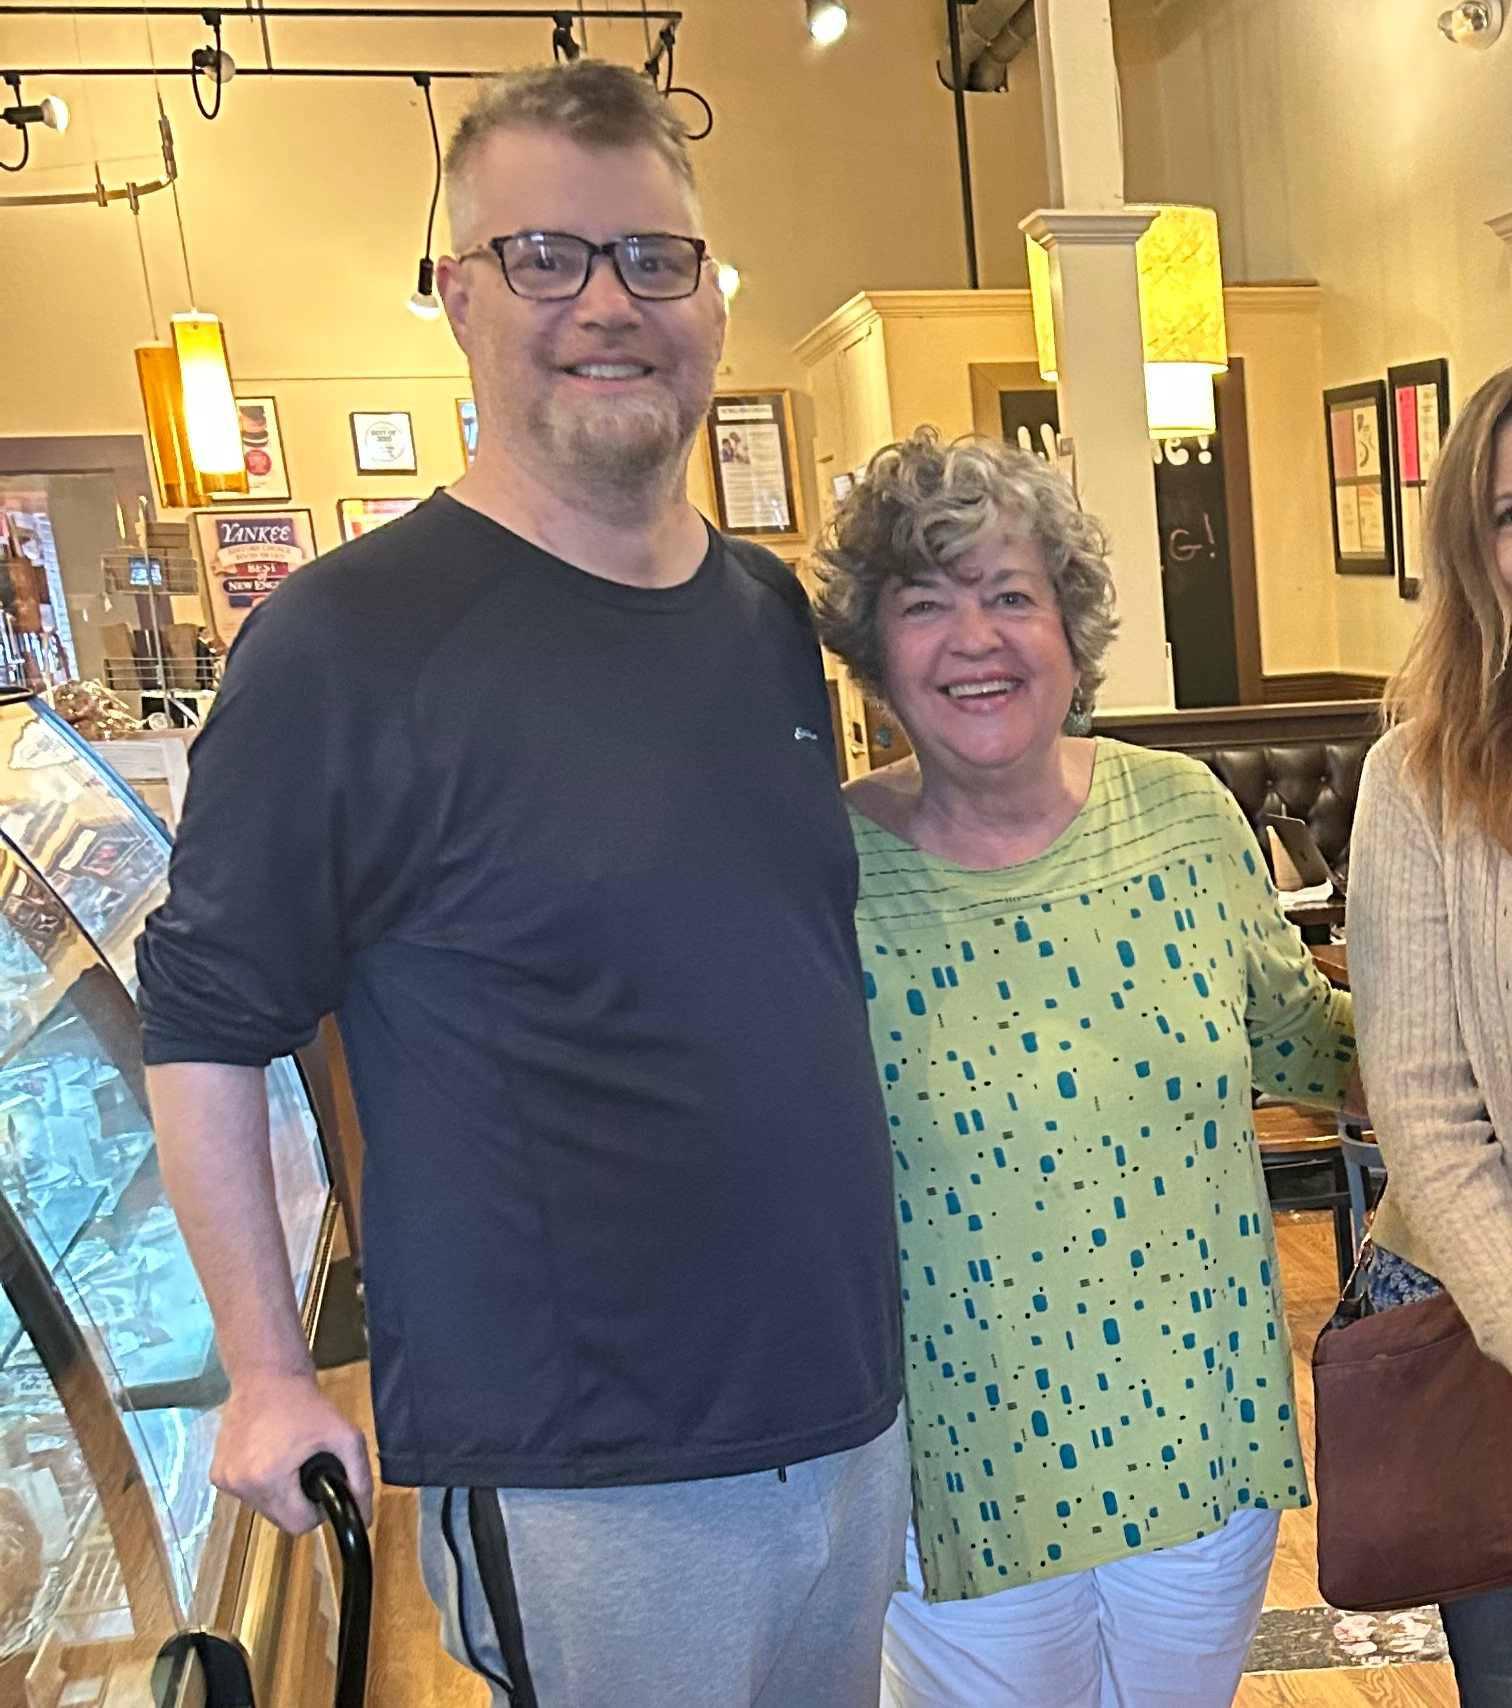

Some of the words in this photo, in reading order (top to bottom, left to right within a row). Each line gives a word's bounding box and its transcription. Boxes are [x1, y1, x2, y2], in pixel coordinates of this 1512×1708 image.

[221, 523, 291, 544] YANKEE
[248, 563, 276, 573] BEST
[228, 581, 253, 591] NEW
